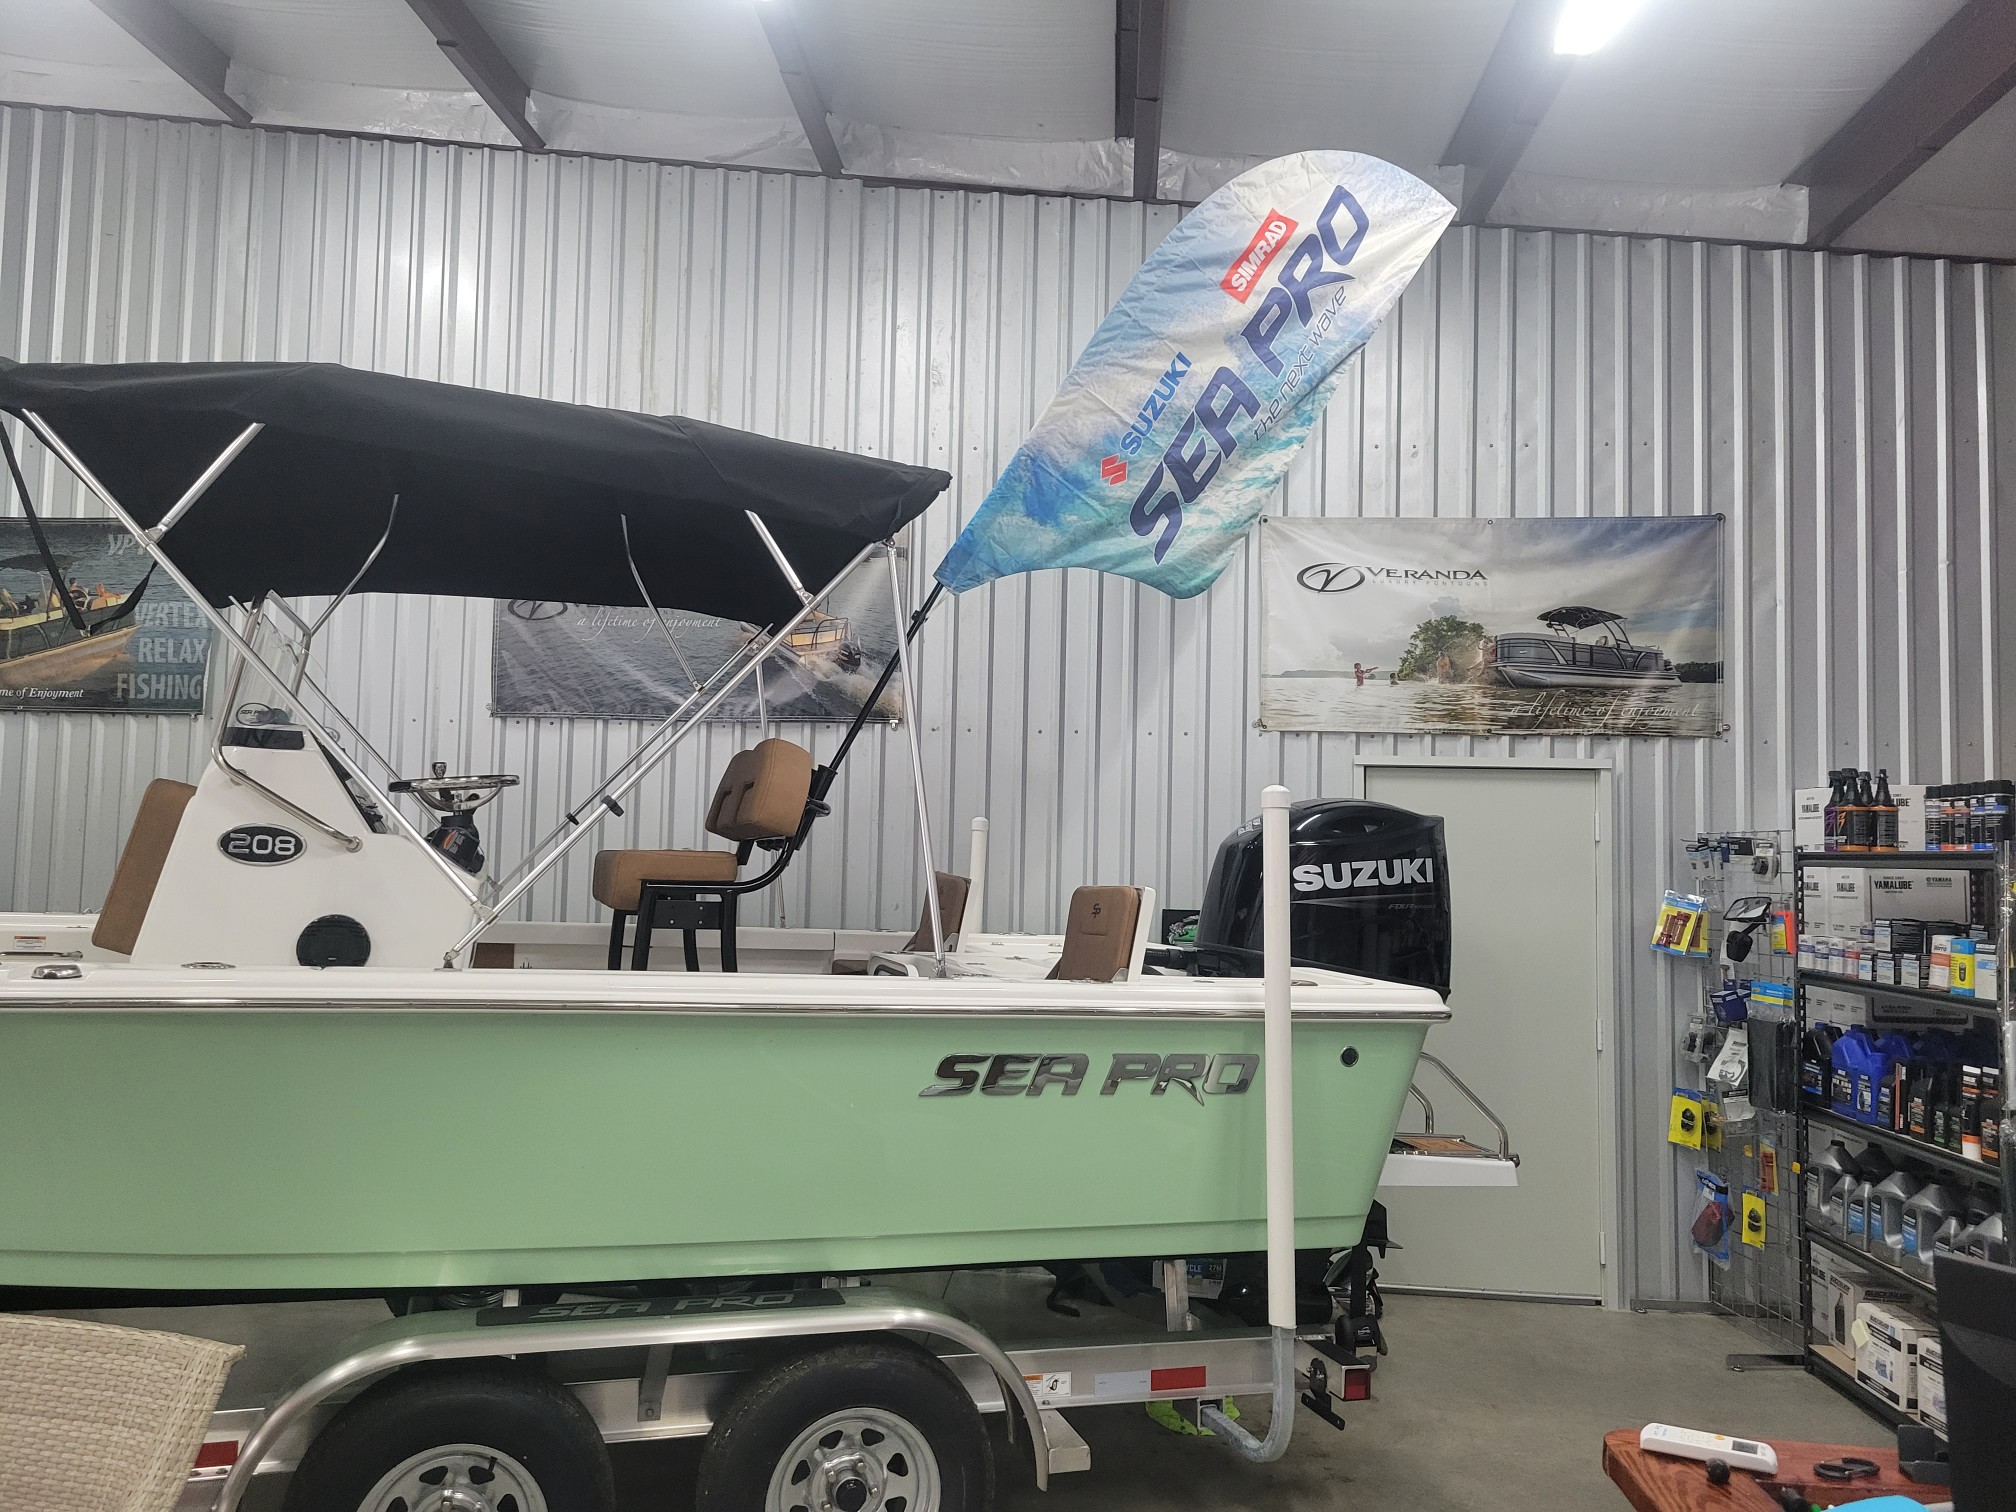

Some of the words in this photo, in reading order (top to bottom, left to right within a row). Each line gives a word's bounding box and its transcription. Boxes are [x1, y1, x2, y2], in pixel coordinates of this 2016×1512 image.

[1231, 219, 1287, 293] SIMRAD
[1128, 366, 1262, 566] SEA
[1240, 184, 1370, 378] PRO
[1253, 398, 1283, 442] the
[1281, 348, 1314, 404] next
[1311, 284, 1348, 354] wave
[1119, 351, 1193, 455] SUZUKI
[1365, 566, 1488, 581] VERANDA
[1372, 578, 1418, 586] LUXURY
[576, 616, 586, 627] a
[581, 606, 638, 642] lifetime
[632, 617, 657, 644] of
[138, 638, 207, 664] RELAX
[16, 686, 29, 700] of
[28, 687, 85, 700] Enjoyment
[117, 673, 203, 700] FISHING
[1510, 704, 1526, 716] a
[1528, 689, 1590, 732] lifetime
[1594, 690, 1629, 734] of
[1620, 703, 1701, 731] enjoyment
[227, 833, 297, 856] 208
[1291, 857, 1435, 893] SUZUKI
[1873, 880, 1913, 890] YAMALUBE
[917, 1053, 1090, 1097] SEA
[1100, 1053, 1261, 1107] PRO
[527, 1300, 652, 1320] SEA
[673, 1293, 794, 1312] PRO
